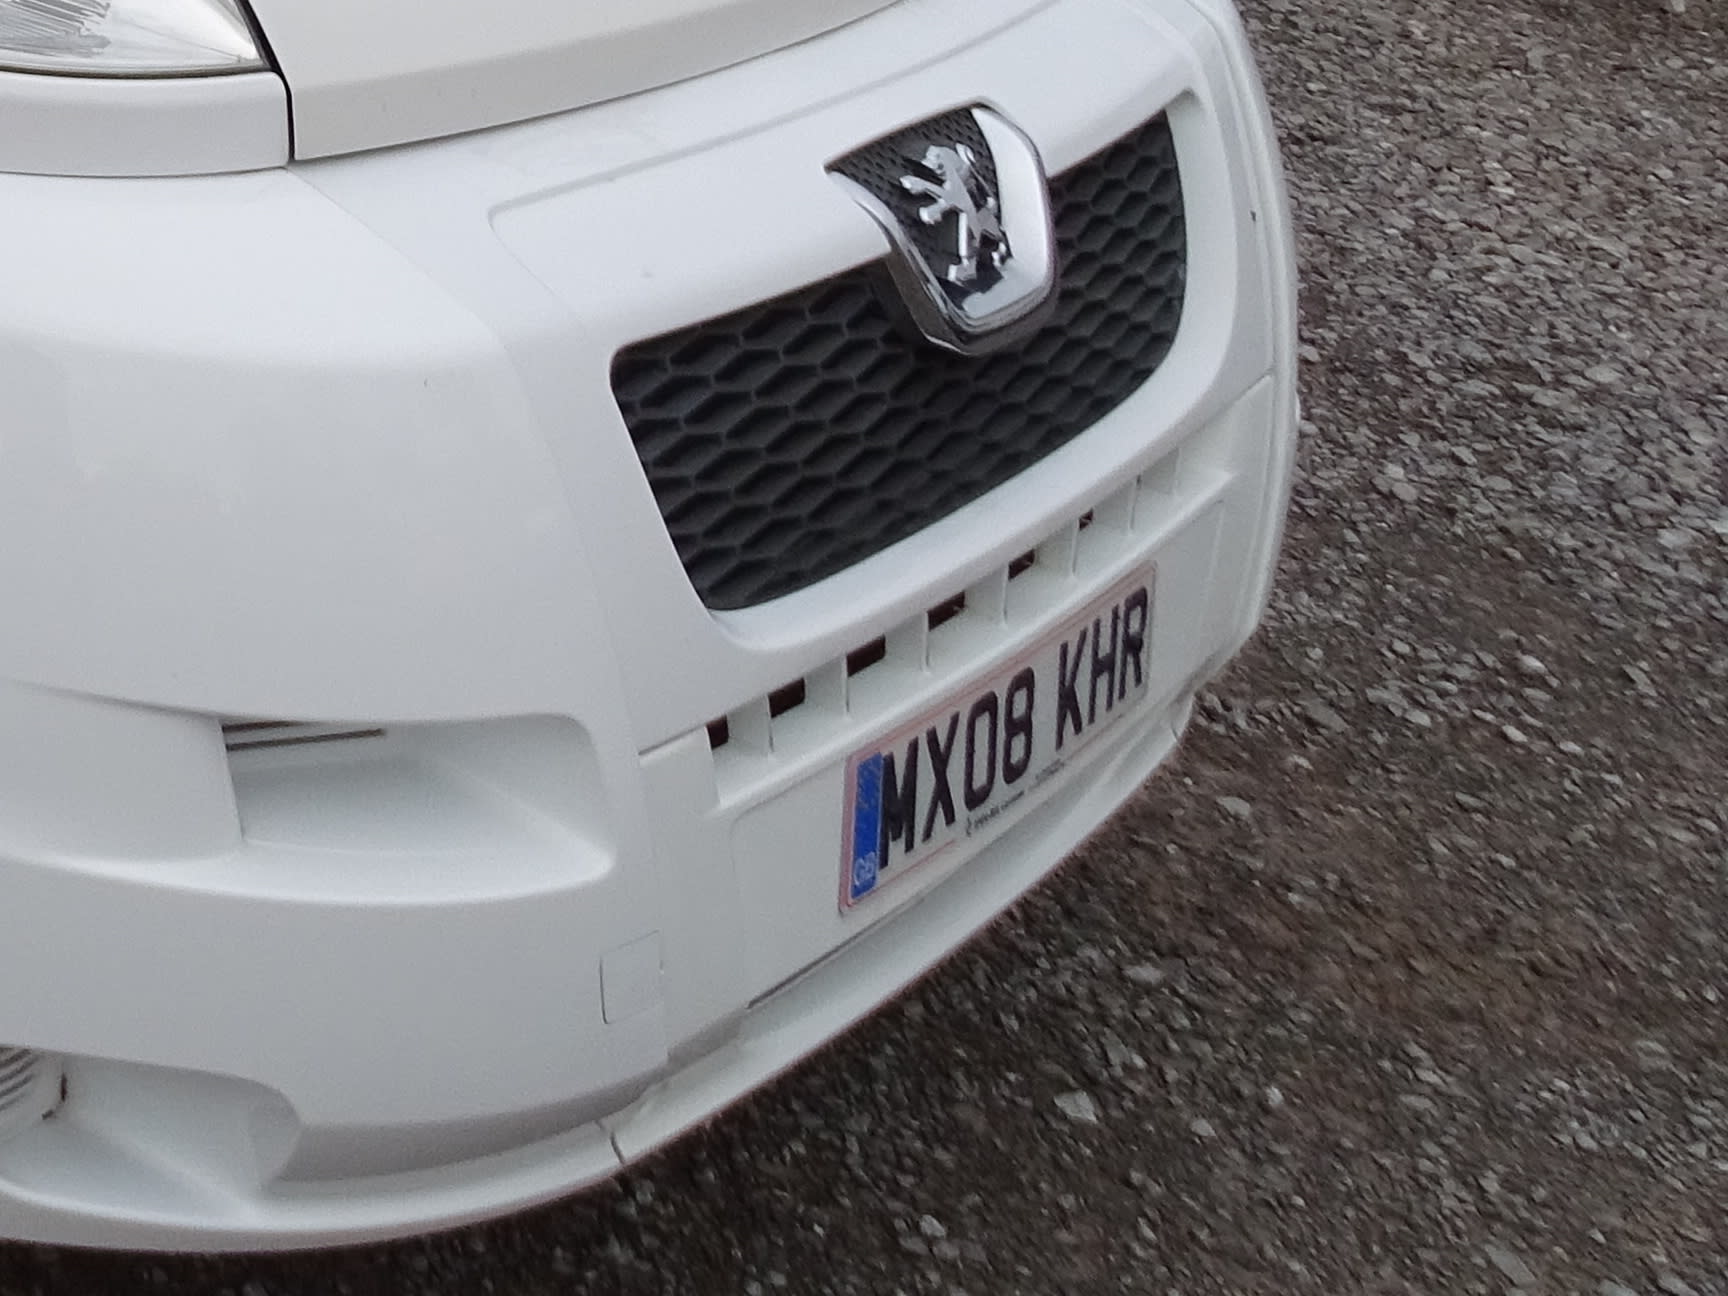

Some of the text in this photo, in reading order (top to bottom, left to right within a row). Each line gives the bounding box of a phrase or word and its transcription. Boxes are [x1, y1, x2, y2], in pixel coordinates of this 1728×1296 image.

[879, 586, 1148, 870] MX08 KHR
[853, 851, 877, 887] GB
